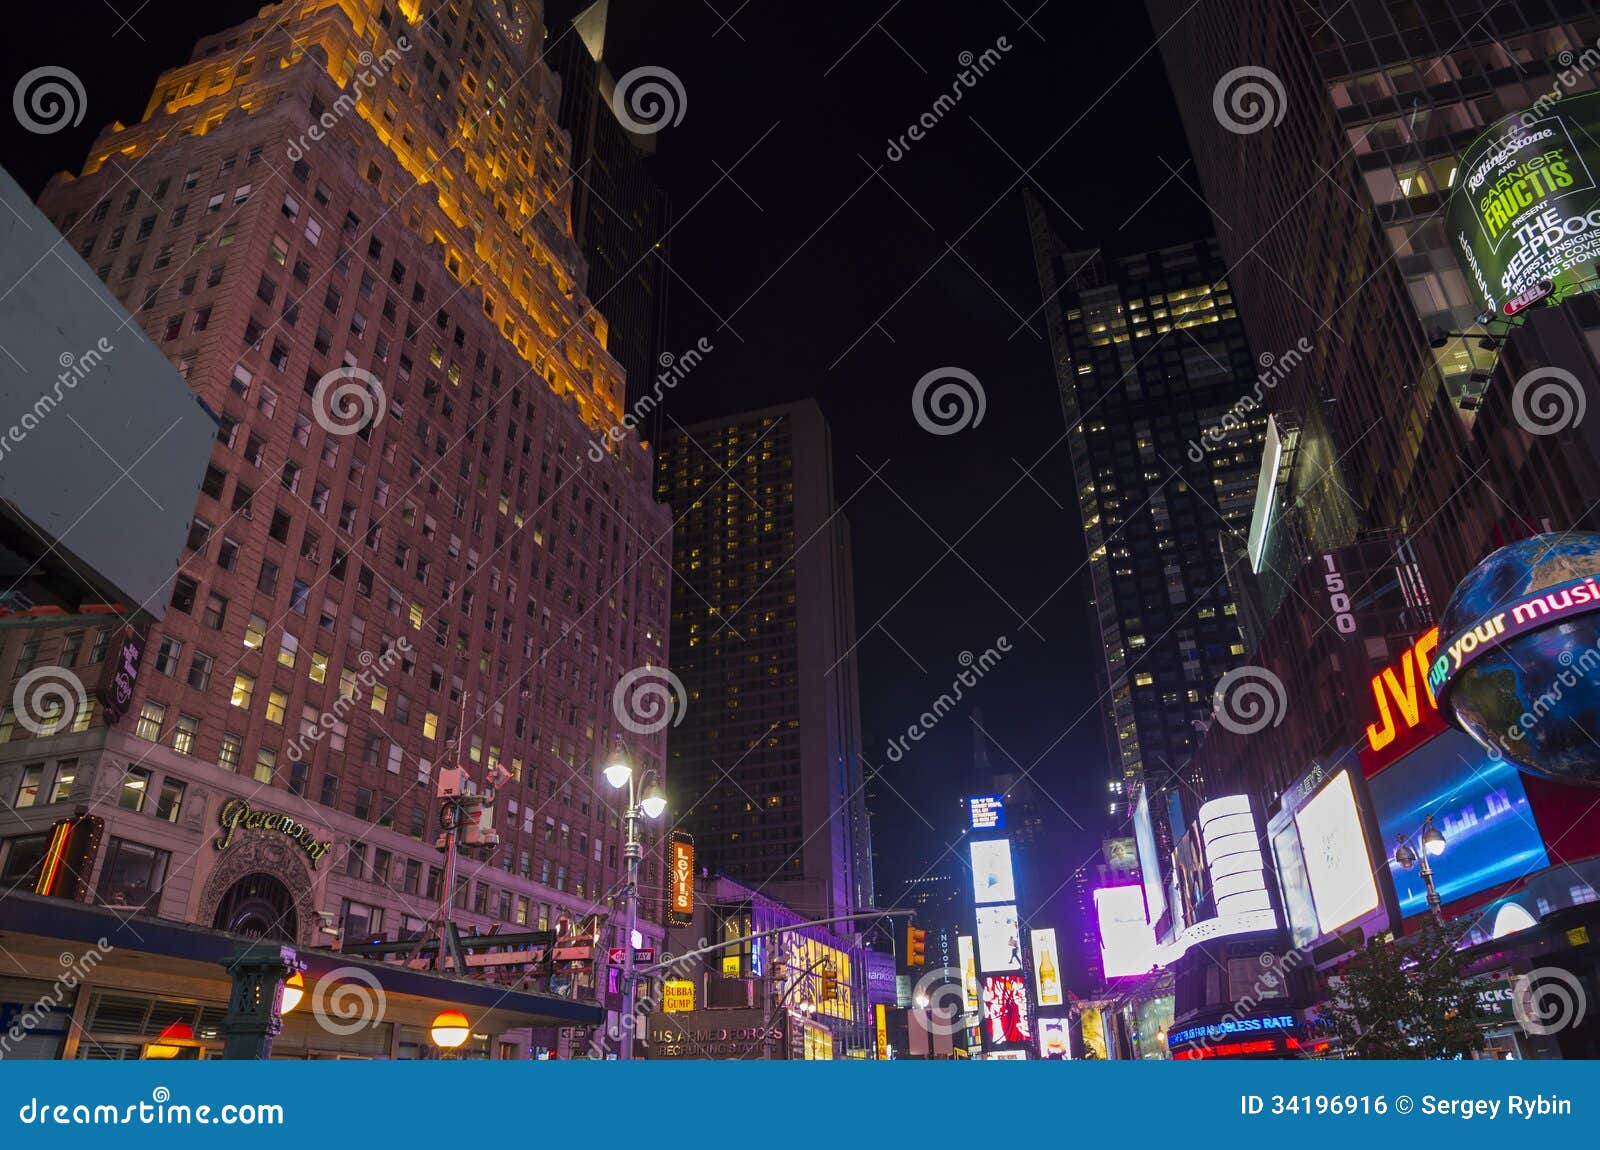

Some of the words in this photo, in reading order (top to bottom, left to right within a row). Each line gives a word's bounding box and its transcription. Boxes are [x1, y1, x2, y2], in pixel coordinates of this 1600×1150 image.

[1480, 150, 1563, 212] GARNIER
[1498, 159, 1517, 176] AND
[1484, 161, 1575, 238] FRUCTIS
[1512, 200, 1548, 228] PRESENT
[1512, 207, 1562, 246] THE
[1512, 275, 1524, 293] THE
[1522, 254, 1545, 278] FIRST
[1526, 270, 1541, 286] ON
[1540, 255, 1564, 272] THE
[1510, 284, 1546, 311] FUEL
[1323, 553, 1357, 634] 1500
[1448, 613, 1505, 669] your
[217, 799, 332, 871] Paramount
[940, 934, 950, 983] NOVOTEL
[665, 985, 693, 996] BUBBA
[667, 998, 691, 1009] GUMP
[1217, 1020, 1261, 1034] JOBLESS
[1263, 1016, 1294, 1029] RATE
